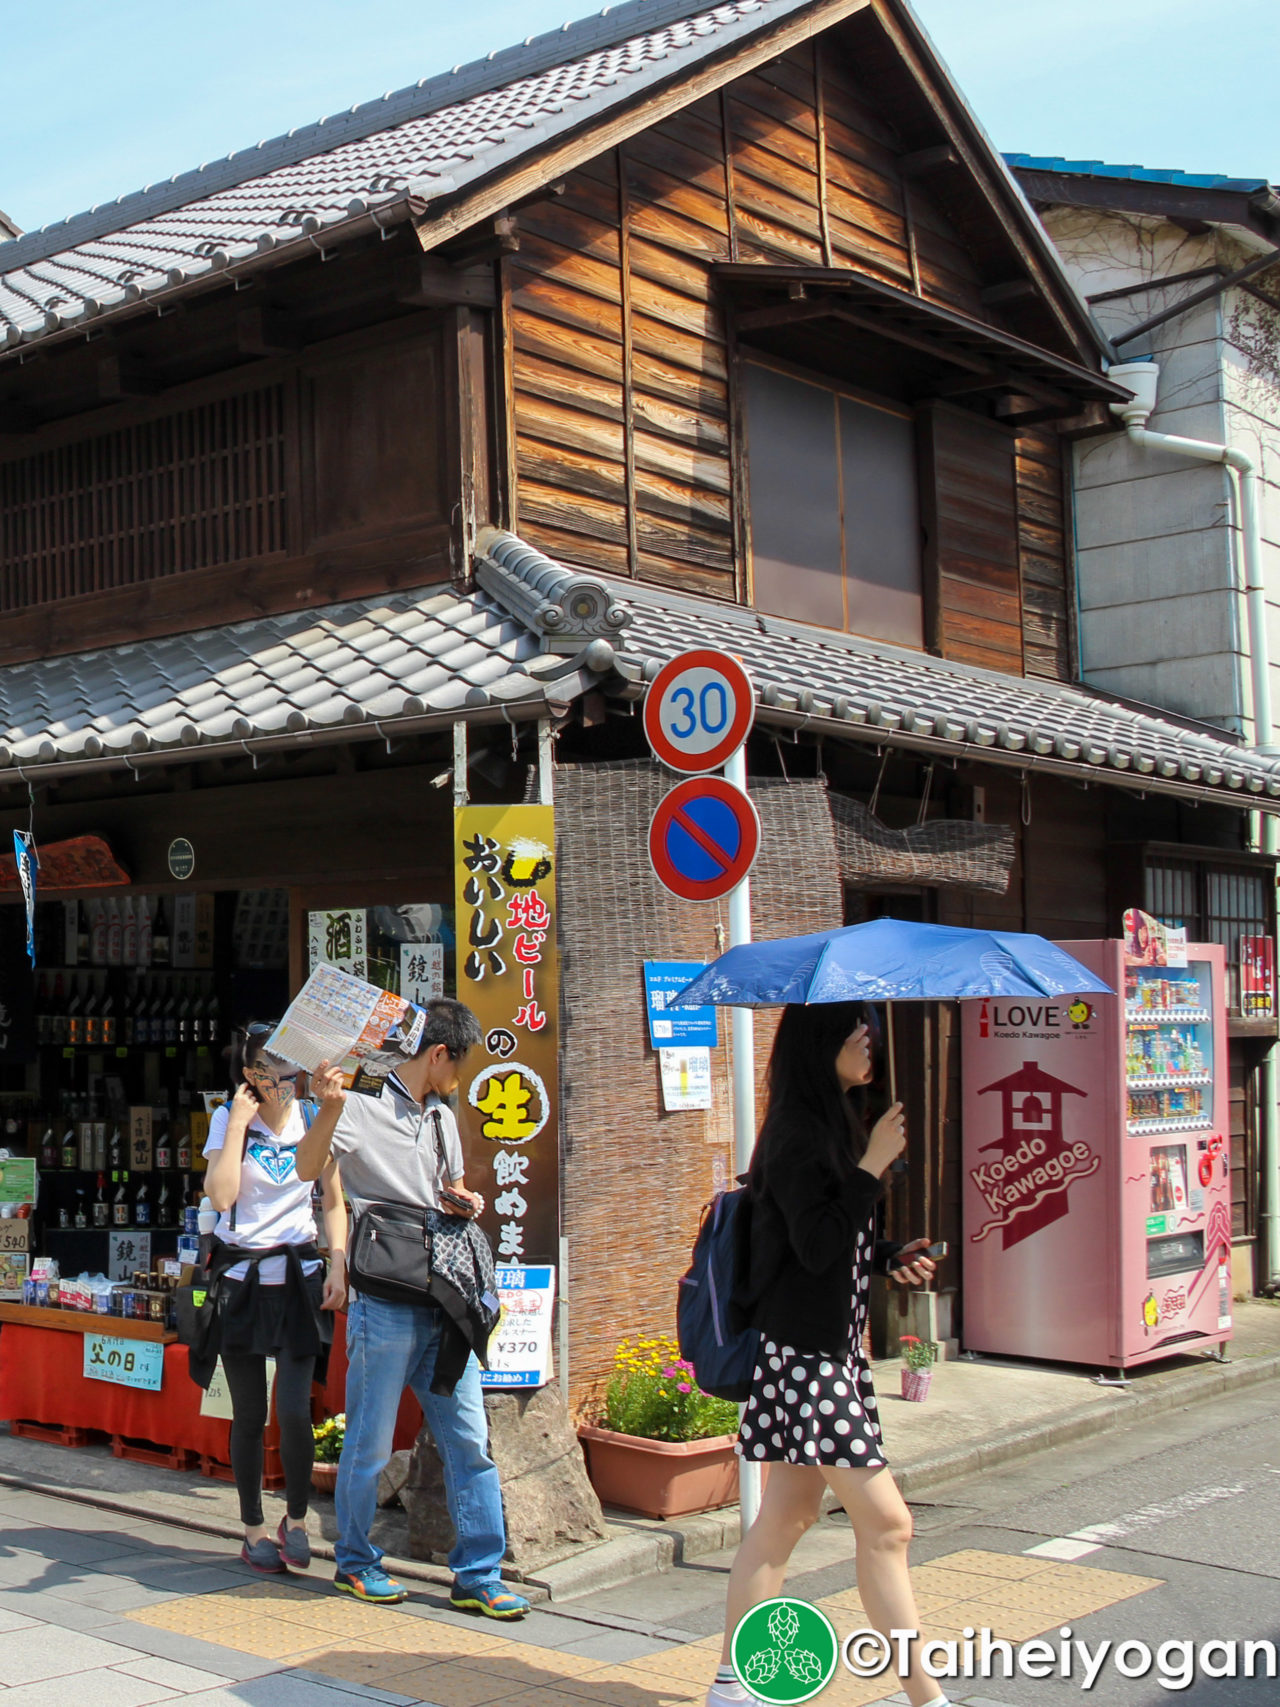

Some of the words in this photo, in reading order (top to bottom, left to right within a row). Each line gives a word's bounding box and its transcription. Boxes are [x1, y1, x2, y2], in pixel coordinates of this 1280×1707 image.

[669, 681, 728, 738] 30
[462, 833, 507, 982] おいしい
[506, 888, 551, 1032] 地ビール
[993, 1006, 1061, 1027] LOVE
[993, 1031, 1020, 1039] Koedo
[1022, 1031, 1061, 1040] Kawagoe
[971, 1138, 1047, 1191] Koedo
[984, 1142, 1090, 1212] Kawagoe
[492, 1149, 531, 1266] 飲めま
[89, 1342, 135, 1373] 父の日
[497, 1341, 538, 1353] ¥370
